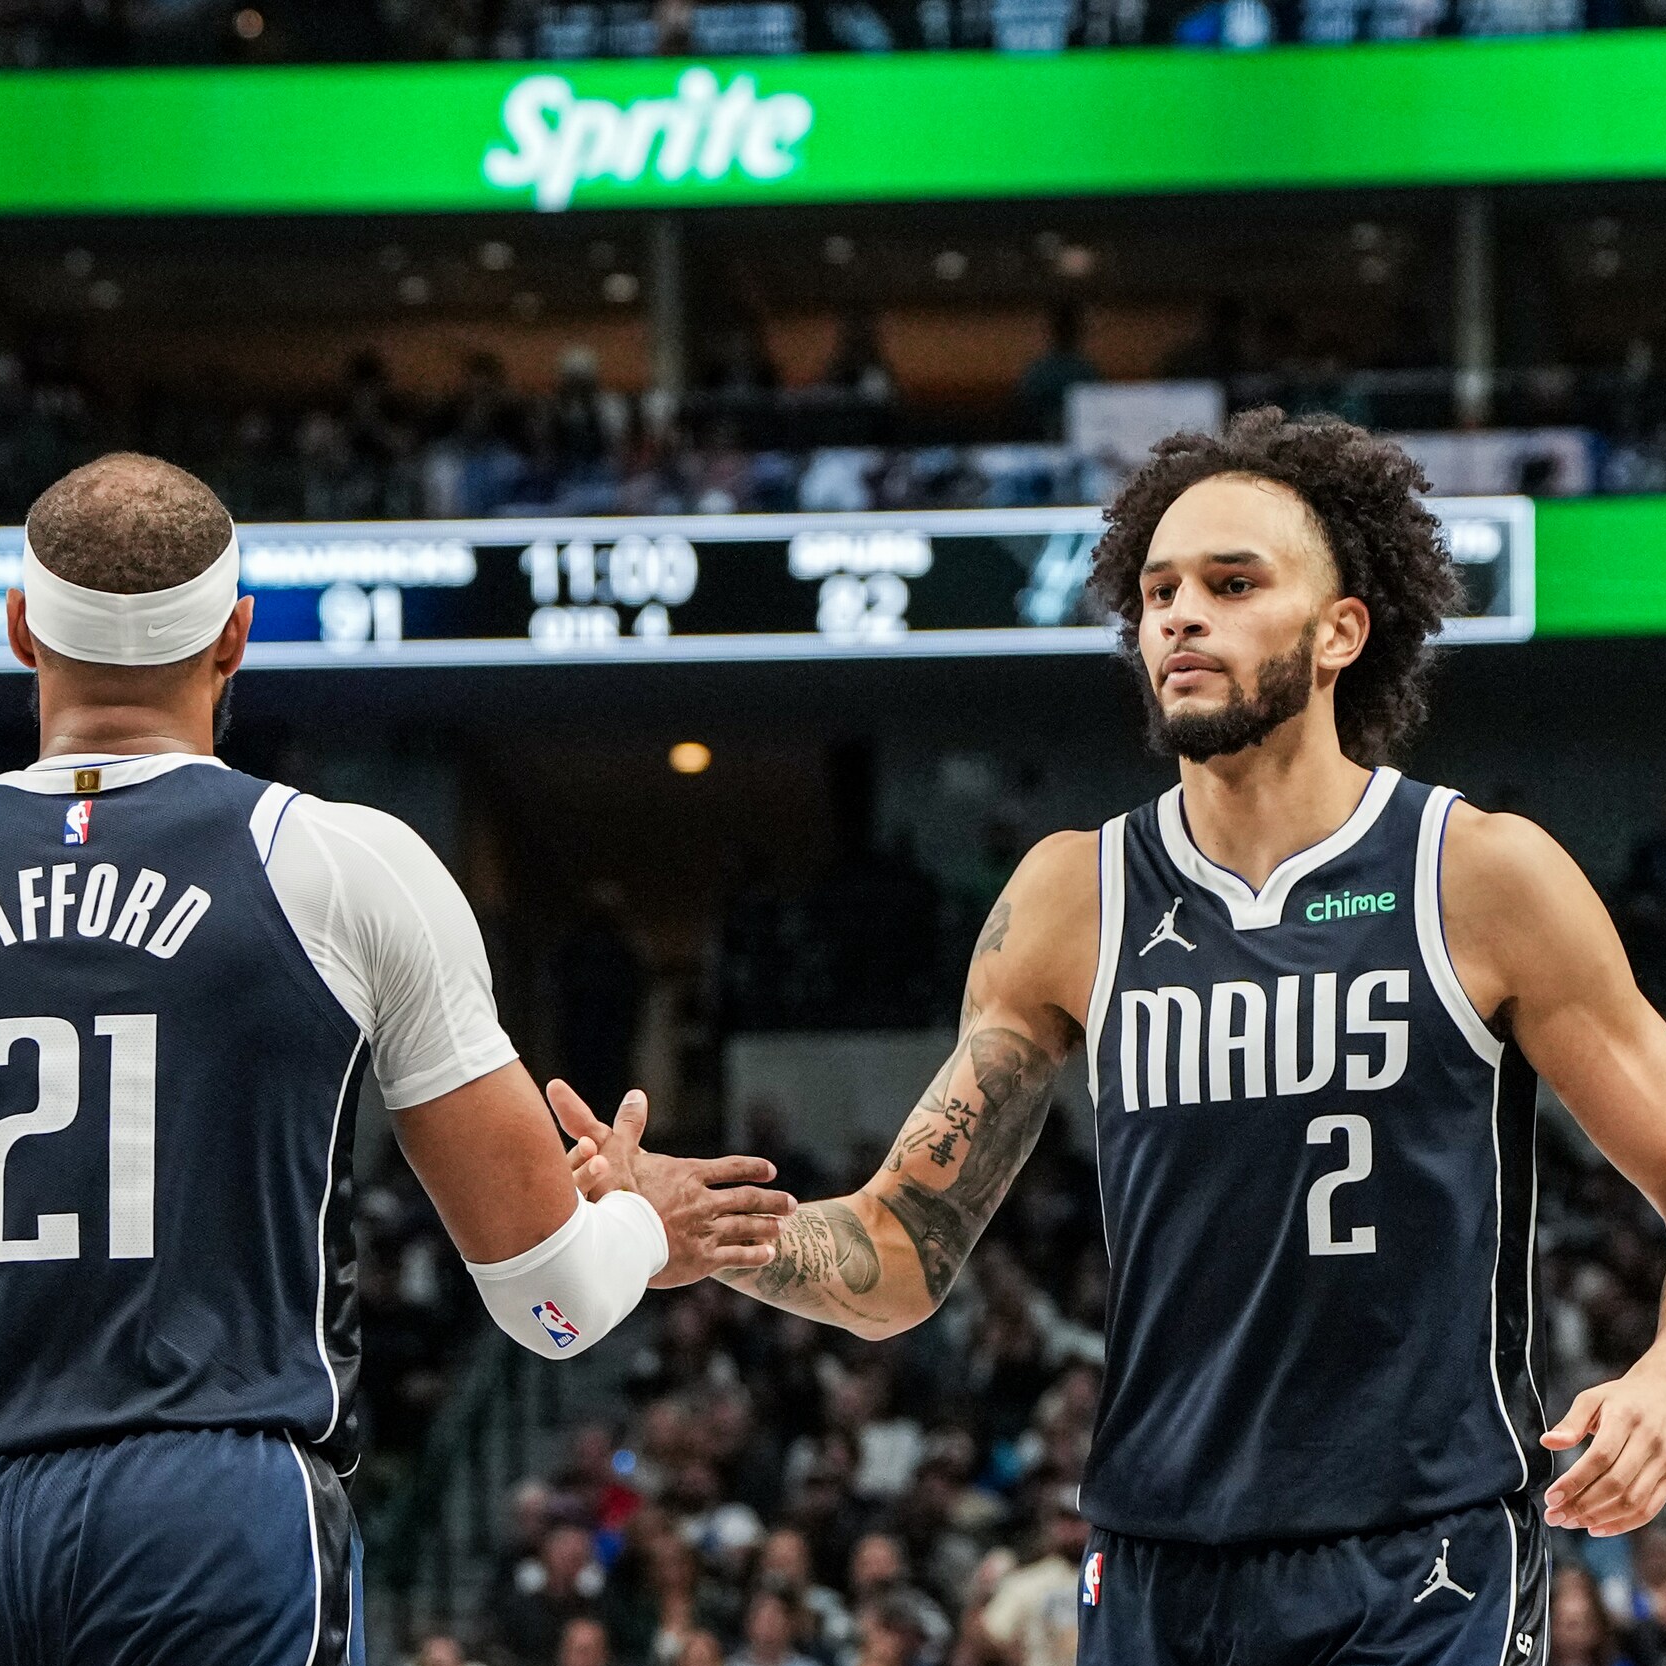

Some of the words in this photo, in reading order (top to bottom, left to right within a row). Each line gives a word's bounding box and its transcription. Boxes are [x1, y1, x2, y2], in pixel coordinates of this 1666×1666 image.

[482, 67, 813, 212] Sprite
[519, 535, 698, 606] 11:00
[1305, 890, 1396, 922] chime
[1121, 969, 1410, 1112] MAVS
[1306, 1114, 1377, 1256] 2
[557, 1334, 573, 1347] NBA
